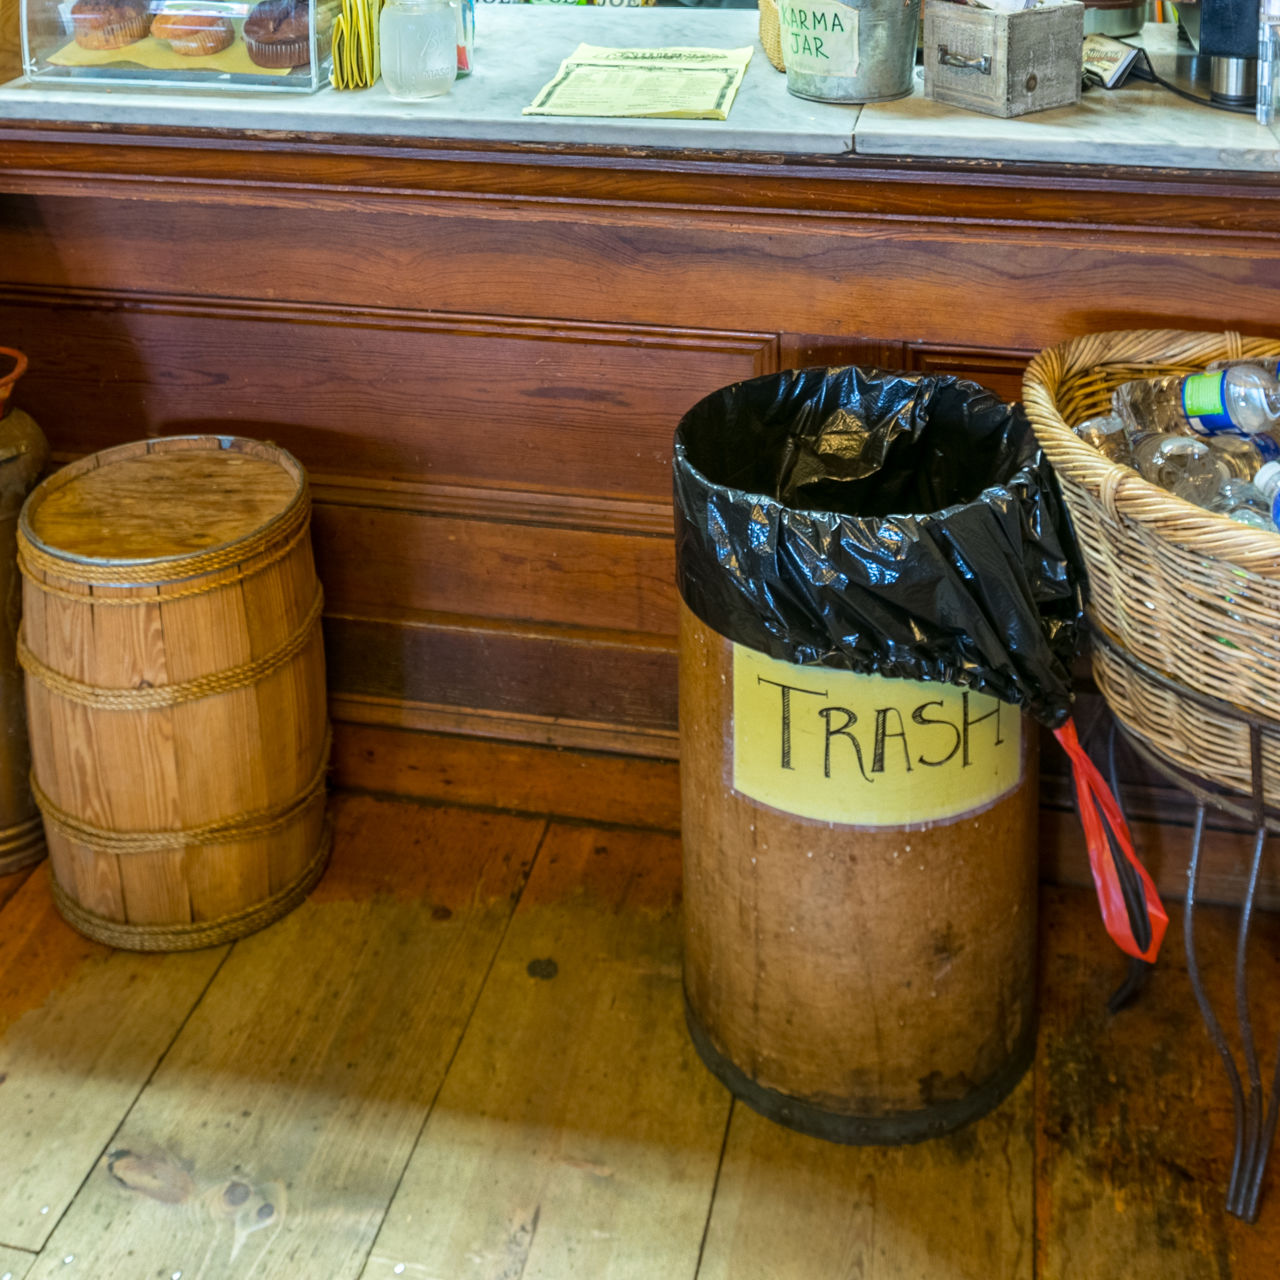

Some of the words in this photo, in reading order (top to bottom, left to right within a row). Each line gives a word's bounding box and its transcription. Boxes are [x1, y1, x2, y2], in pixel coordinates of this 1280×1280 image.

[781, 10, 845, 35] KARMA
[790, 32, 830, 60] JAR
[758, 674, 1004, 783] TRASH
